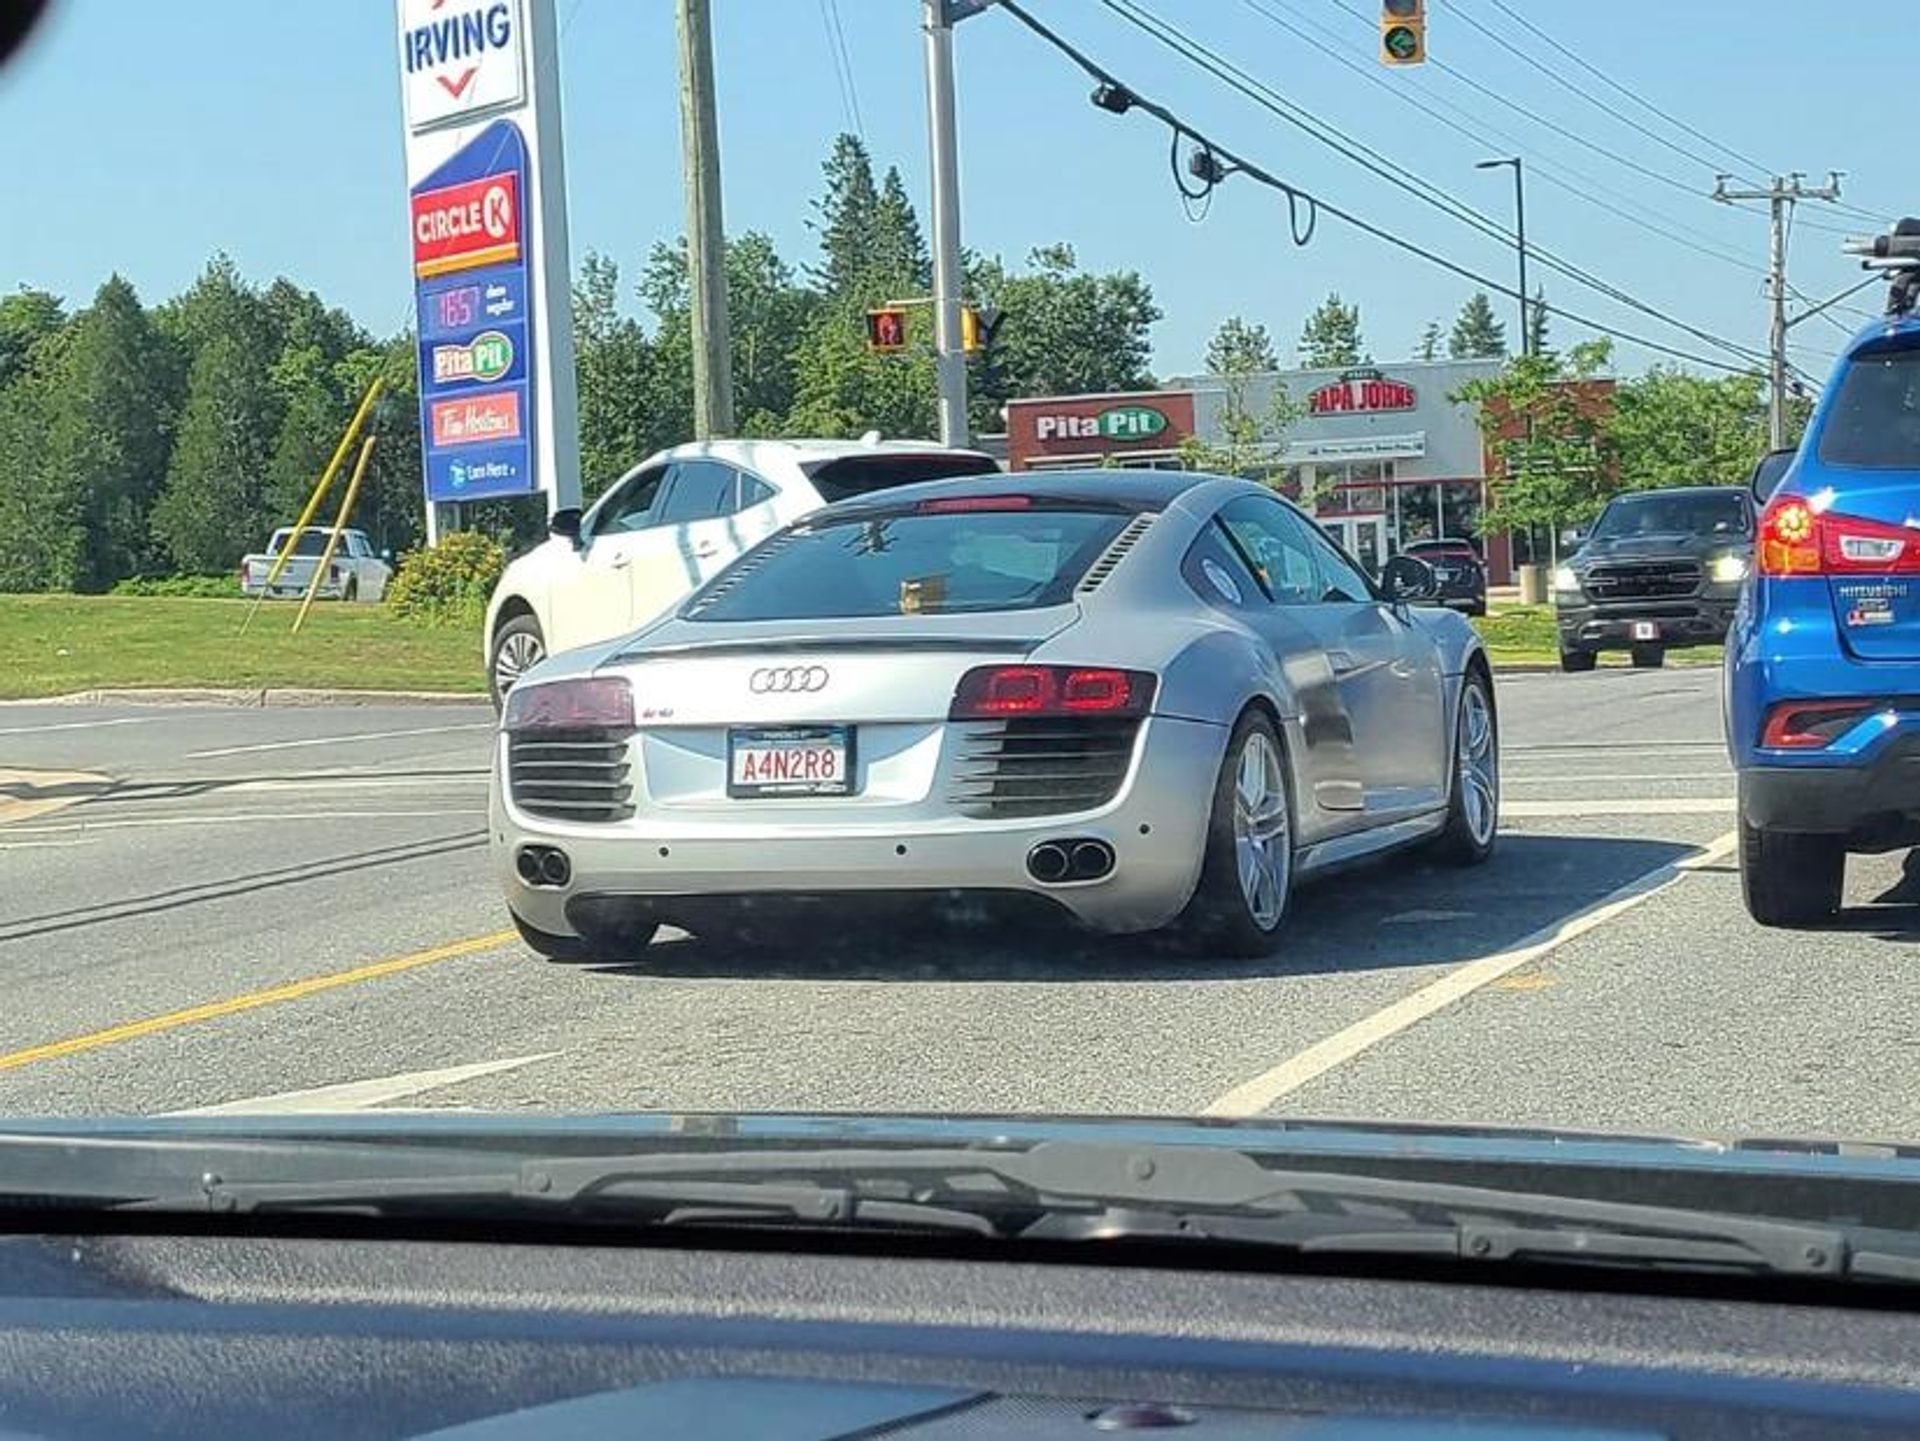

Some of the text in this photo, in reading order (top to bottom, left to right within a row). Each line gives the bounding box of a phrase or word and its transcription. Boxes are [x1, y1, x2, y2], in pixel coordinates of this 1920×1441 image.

[405, 4, 510, 73] IRVING
[417, 186, 511, 243] CIRCLE K
[434, 341, 504, 379] Pita Pit
[1308, 383, 1354, 413] PAPA
[1037, 411, 1152, 439] Pita Pit
[743, 748, 836, 780] A4N2R8
